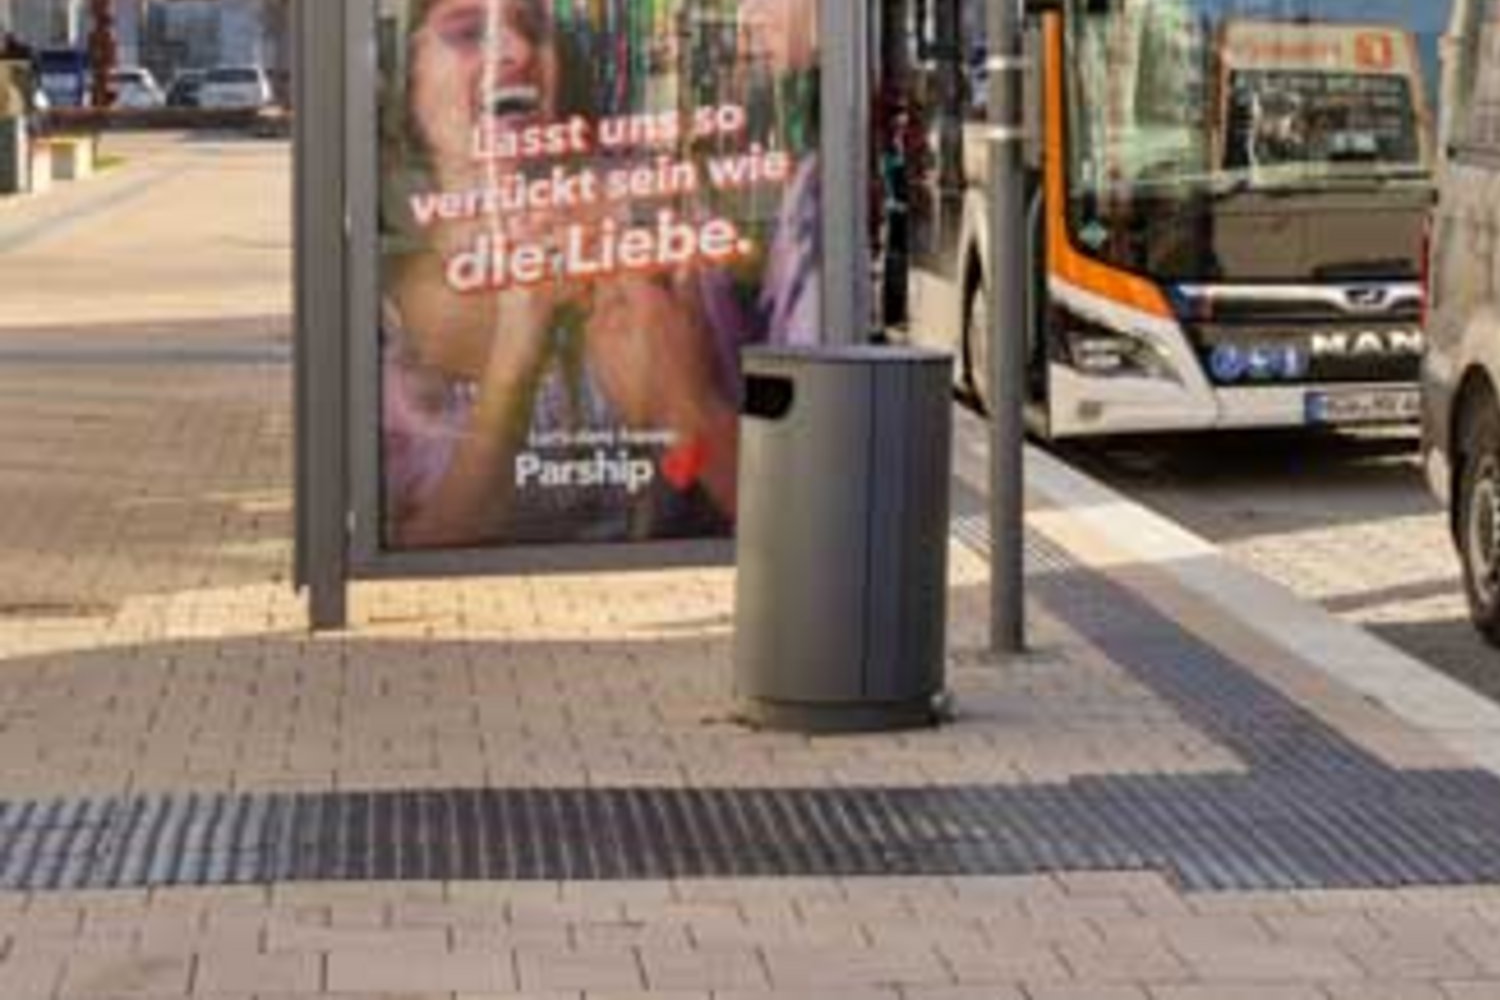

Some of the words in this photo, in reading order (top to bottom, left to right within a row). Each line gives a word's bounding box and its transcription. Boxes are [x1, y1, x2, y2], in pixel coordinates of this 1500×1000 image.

[472, 113, 589, 159] Lasst
[599, 109, 680, 146] uns
[695, 102, 746, 135] so
[411, 163, 598, 224] verrückt
[605, 154, 697, 198] sein
[706, 140, 790, 187] wie
[446, 232, 545, 292] die
[566, 206, 754, 276] Liebe.
[1311, 330, 1422, 355] MAN
[514, 450, 655, 496] Parship
